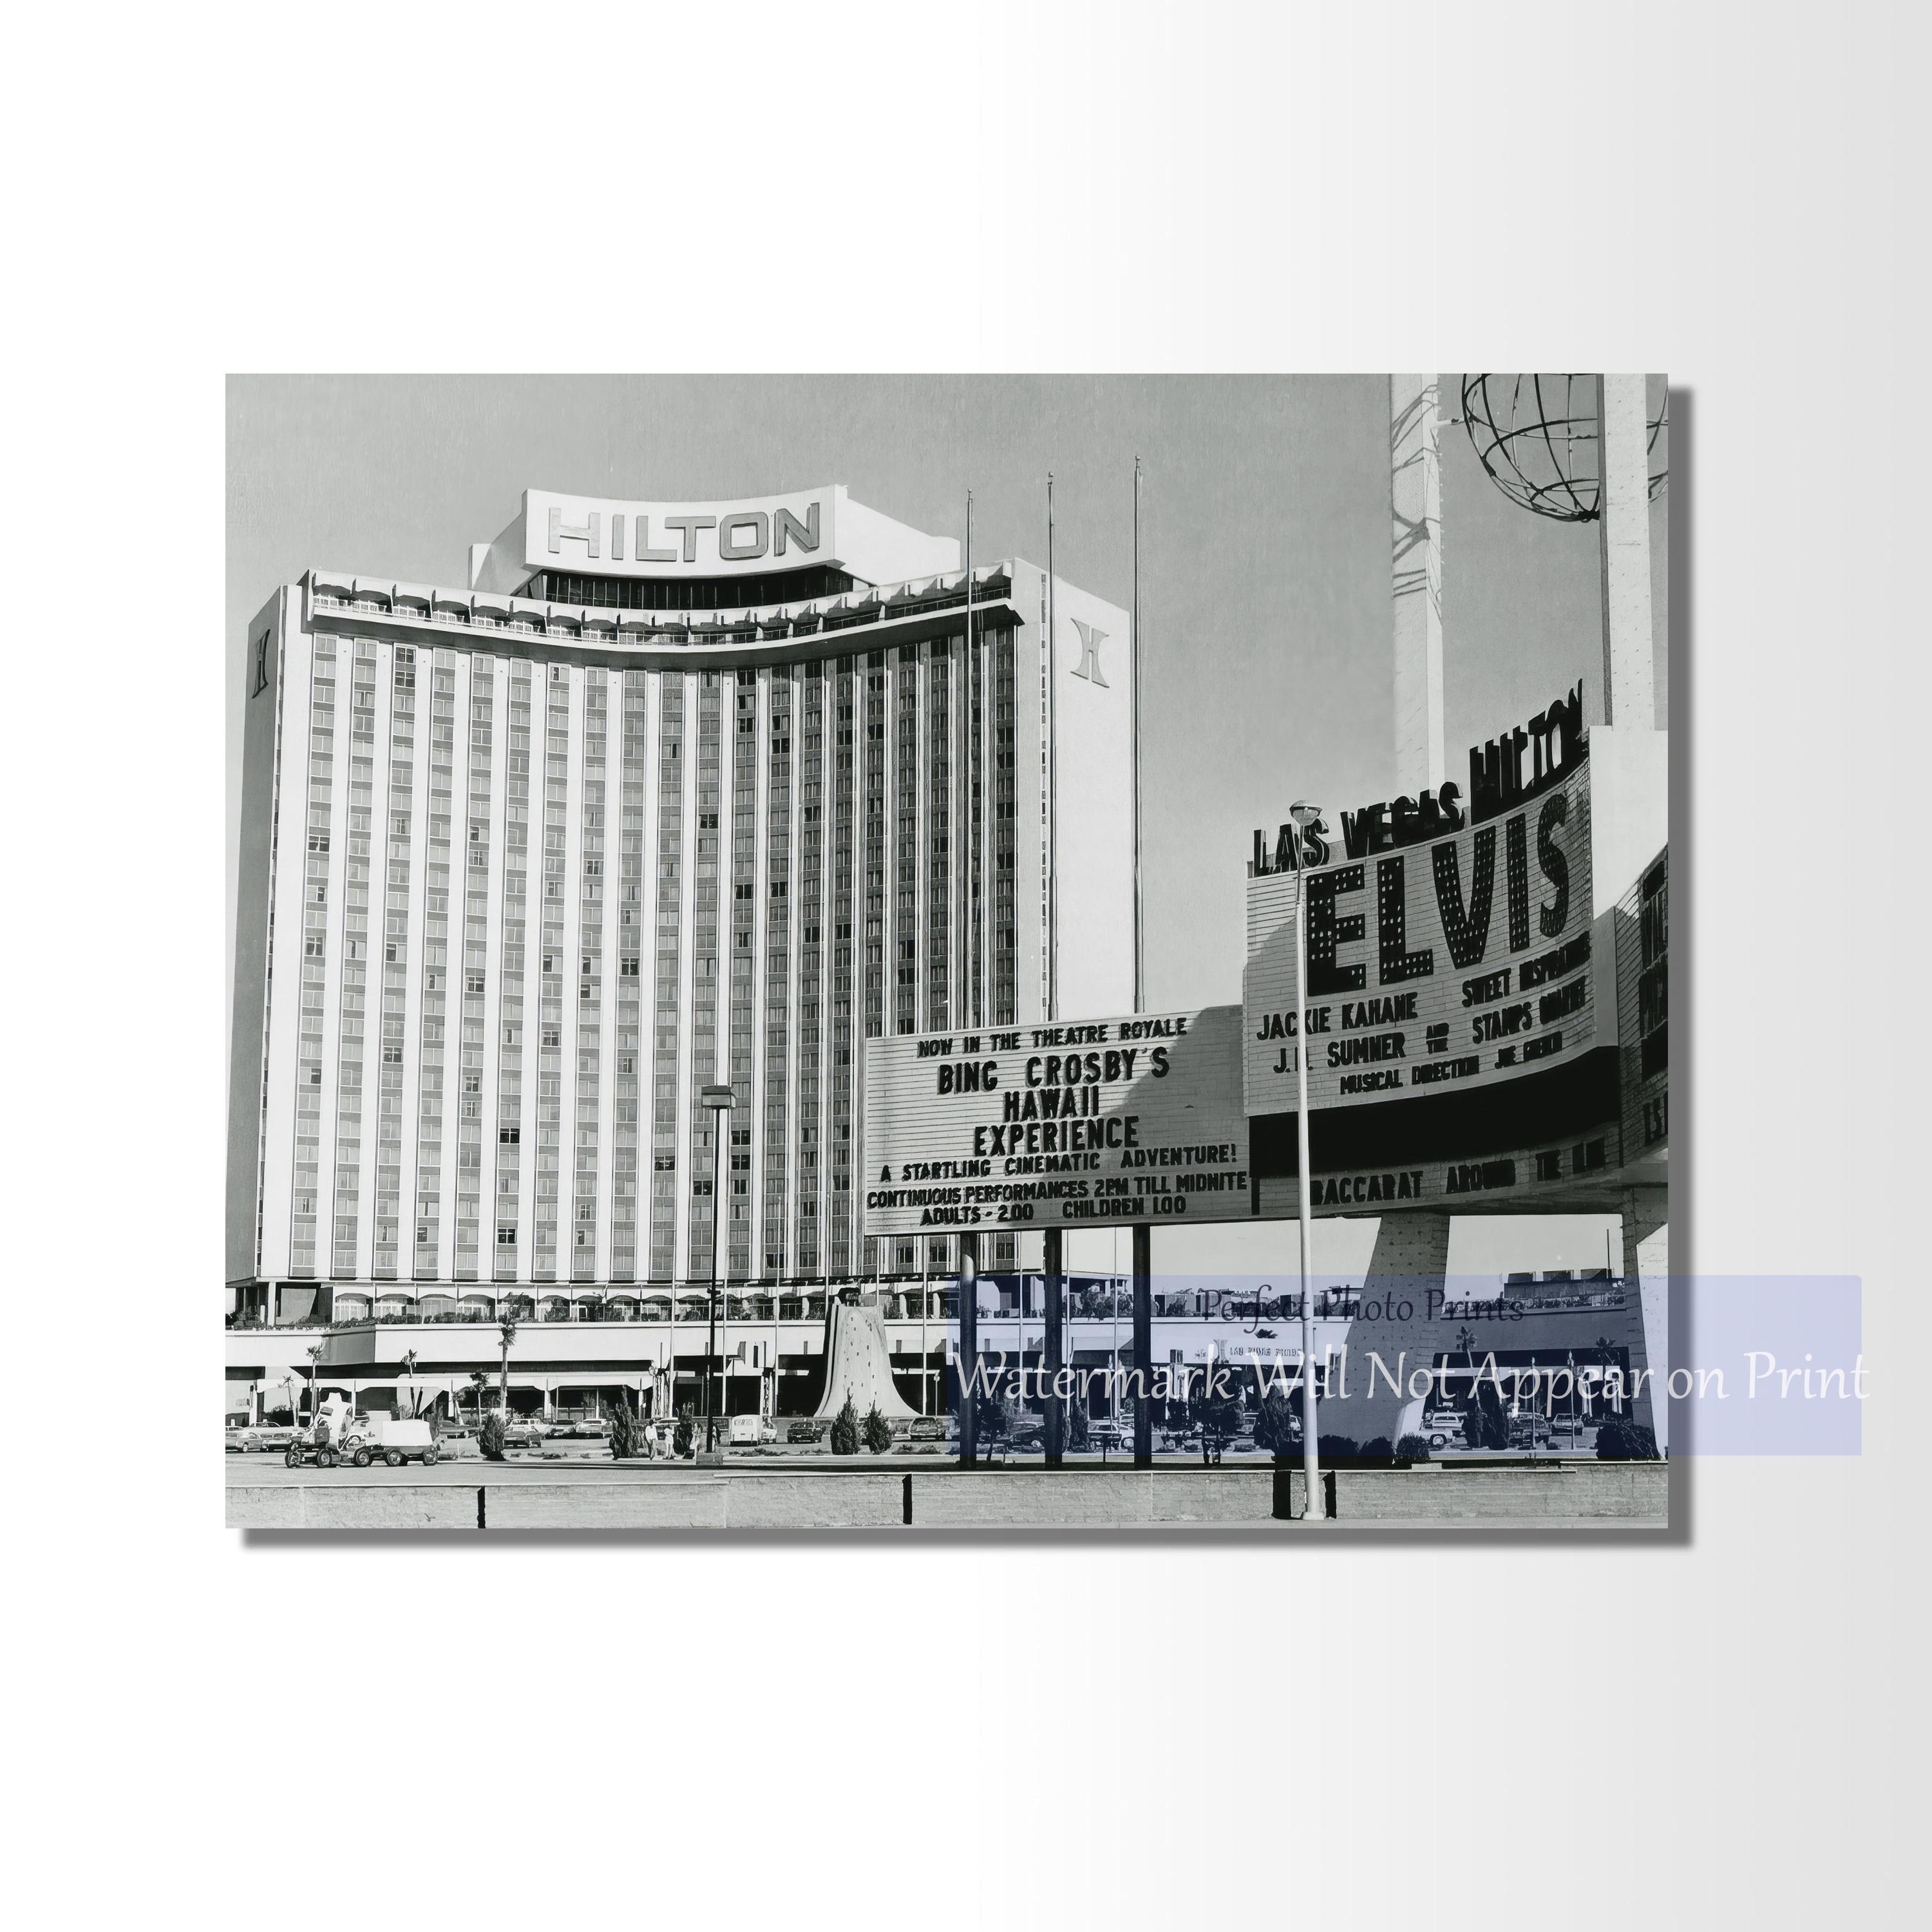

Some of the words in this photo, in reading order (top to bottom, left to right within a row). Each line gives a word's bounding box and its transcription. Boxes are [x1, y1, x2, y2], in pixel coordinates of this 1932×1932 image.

[549, 502, 820, 562] HILTON
[1254, 818, 1329, 876] LAS
[1306, 793, 1569, 996] ELVIS
[1256, 1007, 1331, 1040] JACKIE
[1341, 992, 1418, 1030] KAHANE
[917, 1038, 953, 1057] NOW
[963, 1036, 981, 1053] IN
[990, 1032, 1021, 1051] THE
[1032, 1025, 1108, 1048] THEATRE
[1119, 1018, 1187, 1041] ROYALE
[1327, 1032, 1406, 1068] SUMNER
[938, 1061, 998, 1095] BING
[1025, 1046, 1170, 1088] CROSBY'S
[1340, 1070, 1403, 1095] MUSICAL
[1003, 1085, 1099, 1122] HAWAII
[974, 1115, 1139, 1157] EXPERIENCE
[880, 1165, 891, 1182] A
[902, 1159, 990, 1180] STARTLING
[1005, 1152, 1100, 1176] CINEMATIC
[1121, 1144, 1236, 1168] ADVENTURE!
[867, 1188, 961, 1209] CONTINUOUS
[965, 1180, 1088, 1203] PERFORMANCES
[1095, 1178, 1128, 1197] 2PM
[1133, 1176, 1171, 1195] TILL
[1176, 1171, 1247, 1192] MIDNITE
[1063, 1197, 1144, 1218] CHILDREN
[1310, 1171, 1423, 1206] BACCARAT
[920, 1206, 981, 1226] ADULTS
